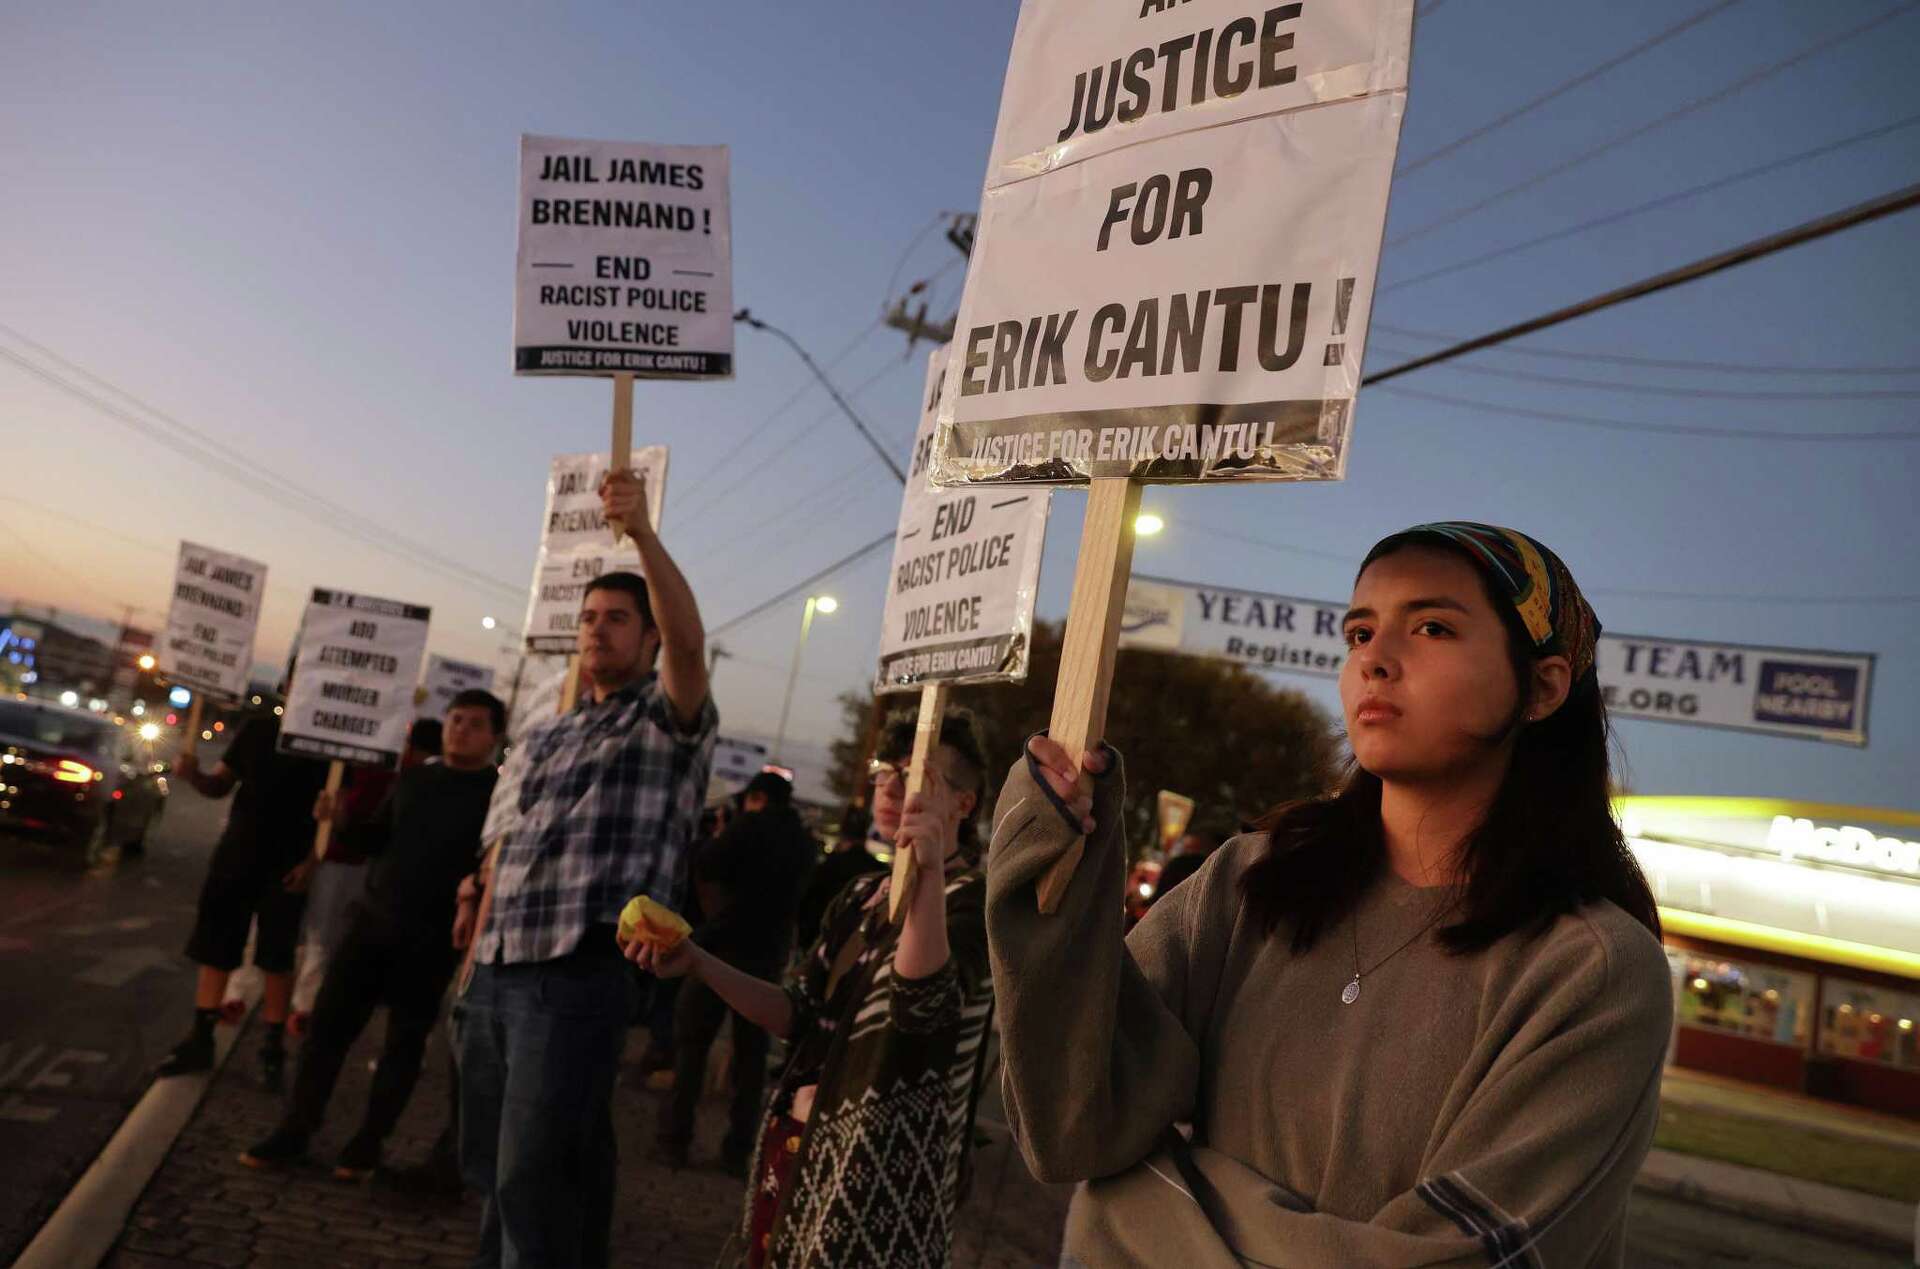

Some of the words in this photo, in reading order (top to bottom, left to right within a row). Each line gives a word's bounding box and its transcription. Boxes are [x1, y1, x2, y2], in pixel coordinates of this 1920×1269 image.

[1058, 3, 1301, 144] JUSTICE
[540, 155, 598, 184] JAIL
[607, 159, 704, 190] JAMES
[532, 200, 695, 232] BRENNAND
[1096, 167, 1213, 252] FOR
[596, 256, 650, 281] END
[540, 285, 620, 307] RACIST
[627, 288, 707, 313] POLICE
[568, 320, 679, 346] VIOLENCE
[960, 309, 1079, 397] ERIK
[1084, 282, 1312, 384] CANTU
[541, 351, 592, 366] JUSTICE
[595, 351, 621, 367] FOR
[624, 353, 654, 368] ERIK
[970, 431, 1046, 467] JUSTICE
[1047, 427, 1093, 462] FOR
[1096, 425, 1160, 461] ERIK
[1162, 422, 1260, 461] CANTU
[930, 496, 976, 542] END
[897, 551, 945, 596] RACIST
[947, 532, 1015, 585] POLICE
[902, 595, 982, 643] VIOLENCE
[1198, 591, 1296, 634] YEAR
[1622, 642, 1745, 685] TEAM
[319, 645, 398, 674] ATTEMPTED
[1226, 637, 1342, 668] Register
